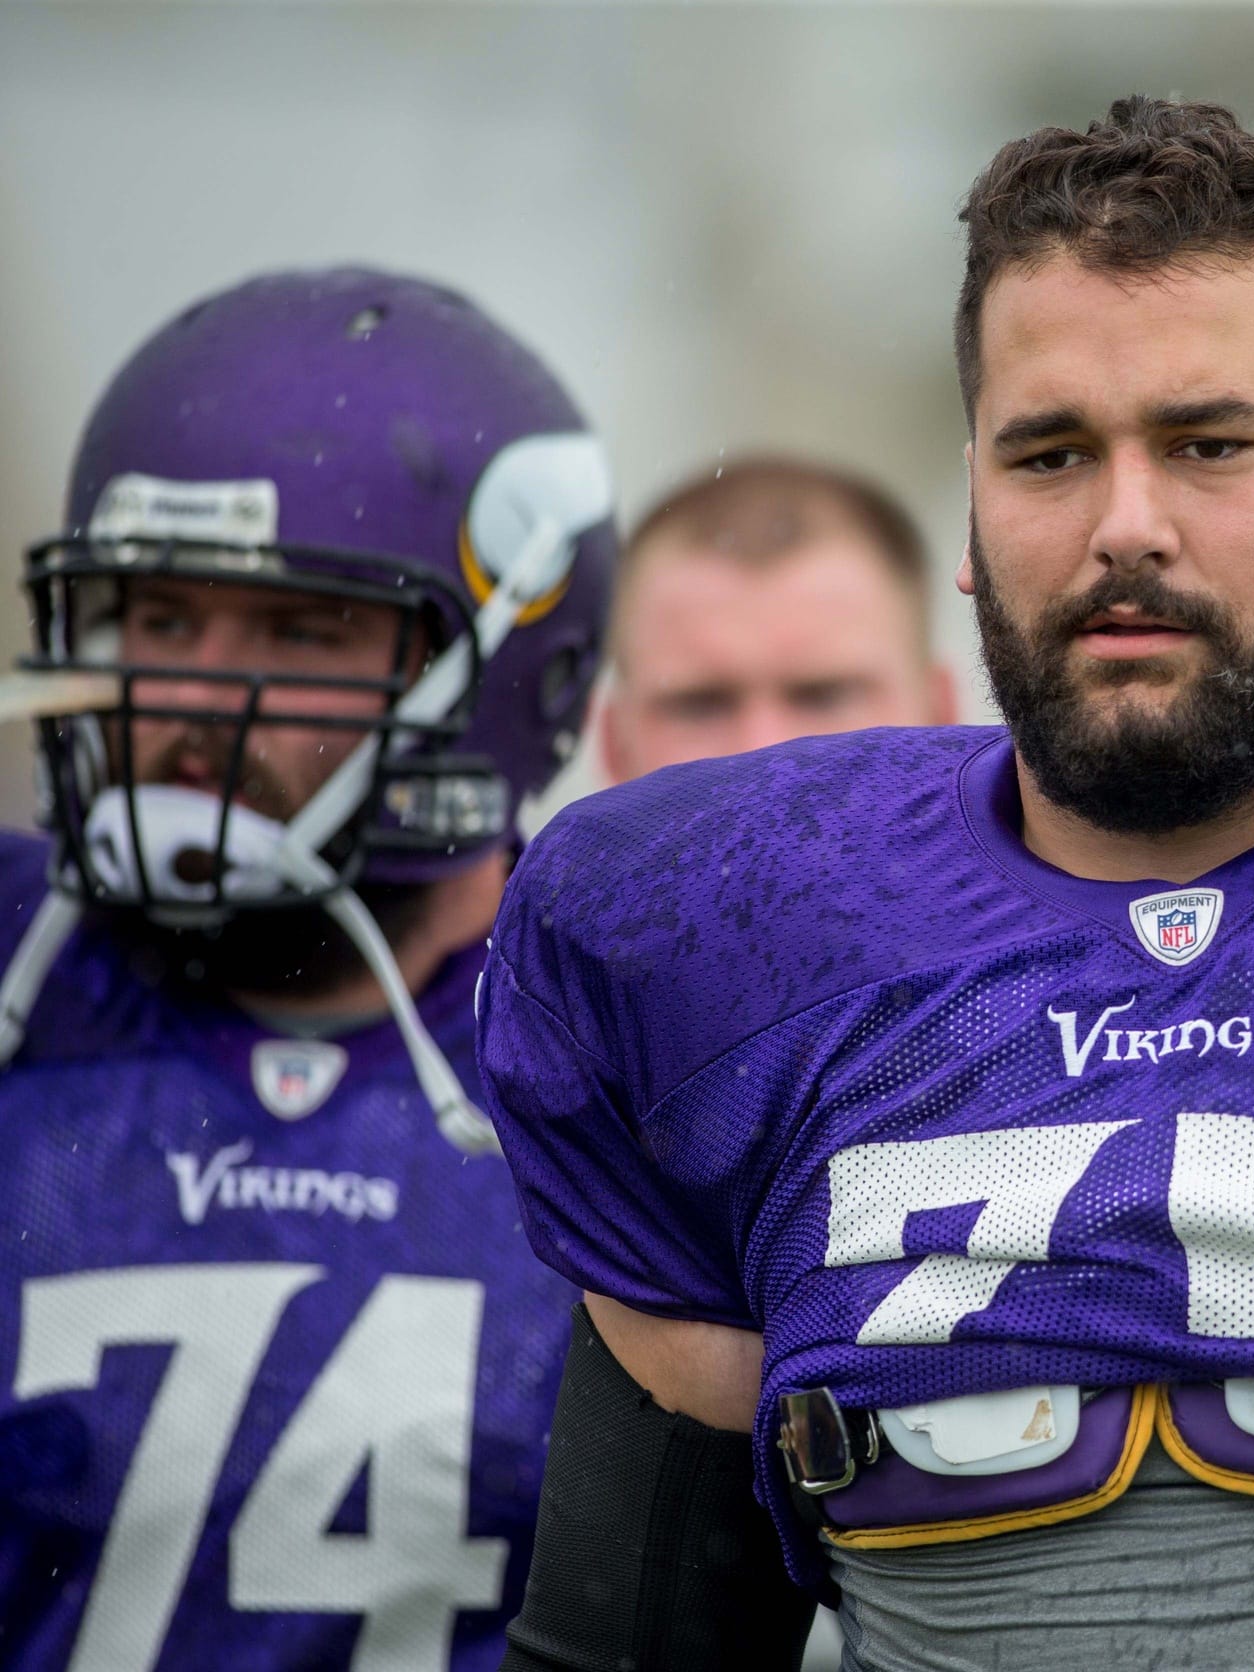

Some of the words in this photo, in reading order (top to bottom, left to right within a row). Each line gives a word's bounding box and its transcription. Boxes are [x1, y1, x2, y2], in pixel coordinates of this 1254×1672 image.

[1142, 896, 1212, 915] EQUIPMENT
[1162, 926, 1194, 948] NFL
[13, 1260, 510, 1671] 74
